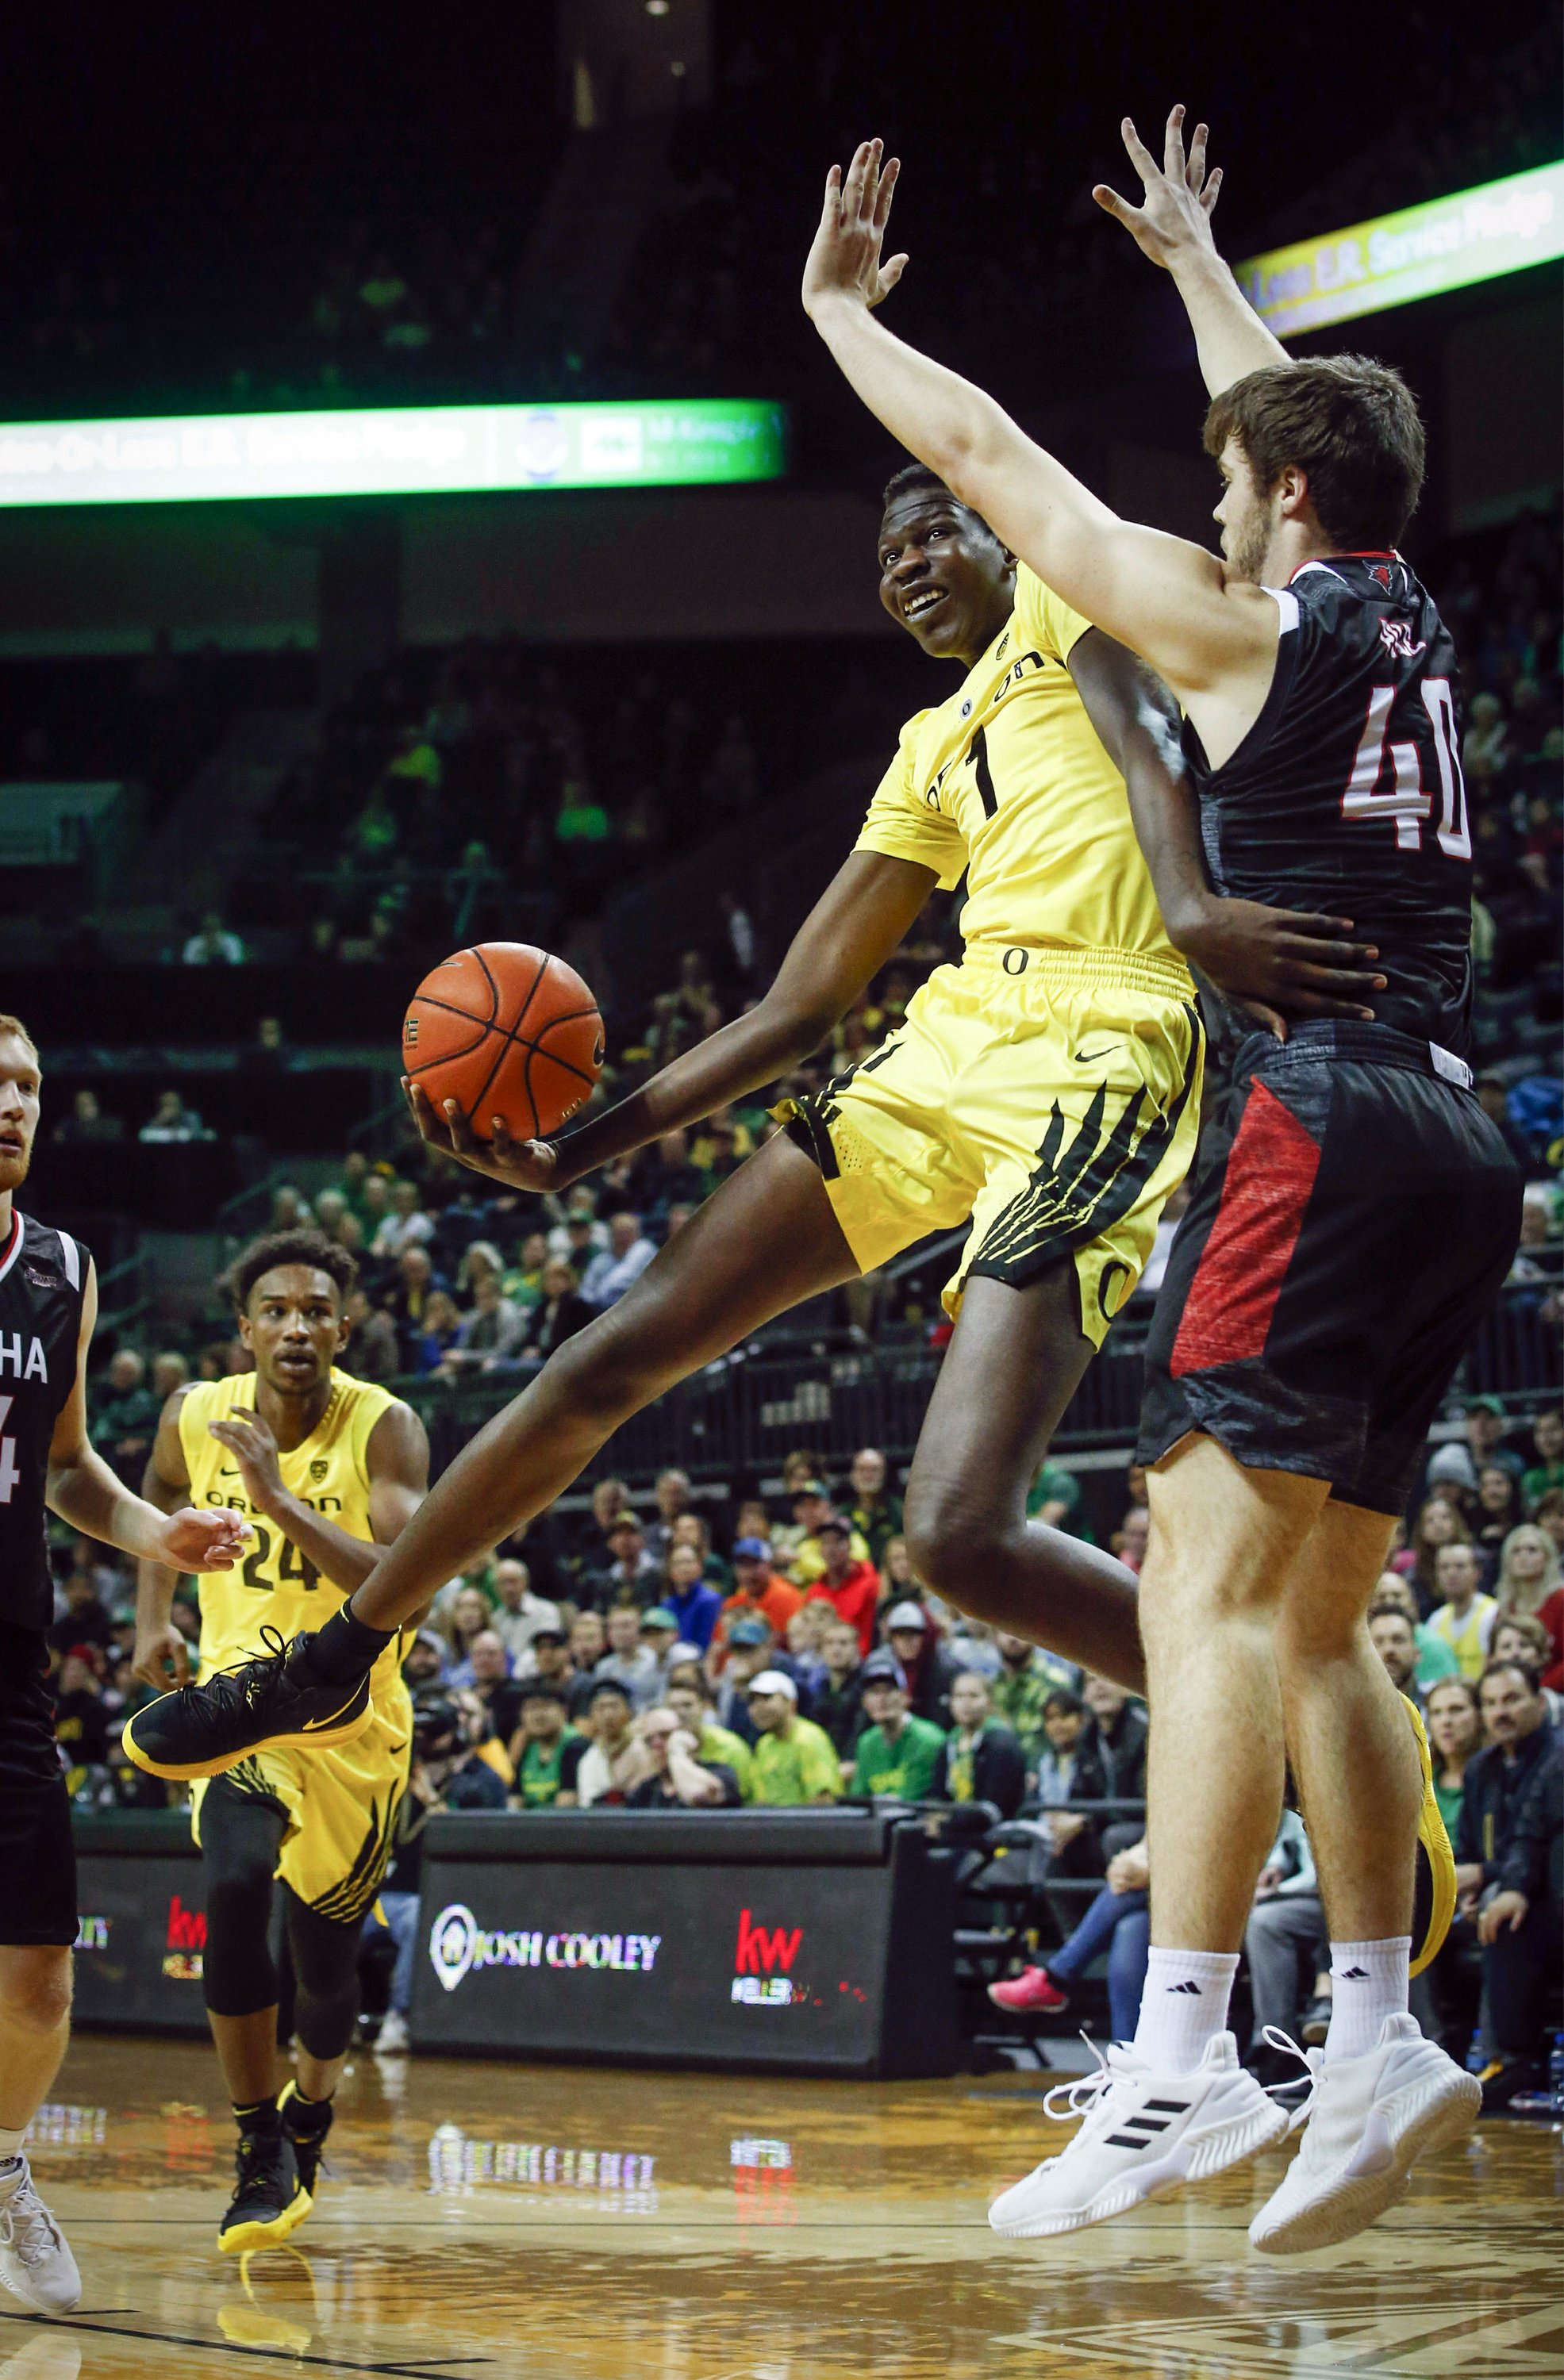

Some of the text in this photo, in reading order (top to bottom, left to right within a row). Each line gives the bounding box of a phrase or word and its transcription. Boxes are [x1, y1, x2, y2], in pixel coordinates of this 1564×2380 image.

[966, 724, 998, 820] 1
[1341, 676, 1472, 862] 40
[1002, 947, 1029, 975] O
[243, 1525, 321, 1591] 24
[546, 1932, 662, 1971] COOLEY
[736, 1908, 803, 1973] kw
